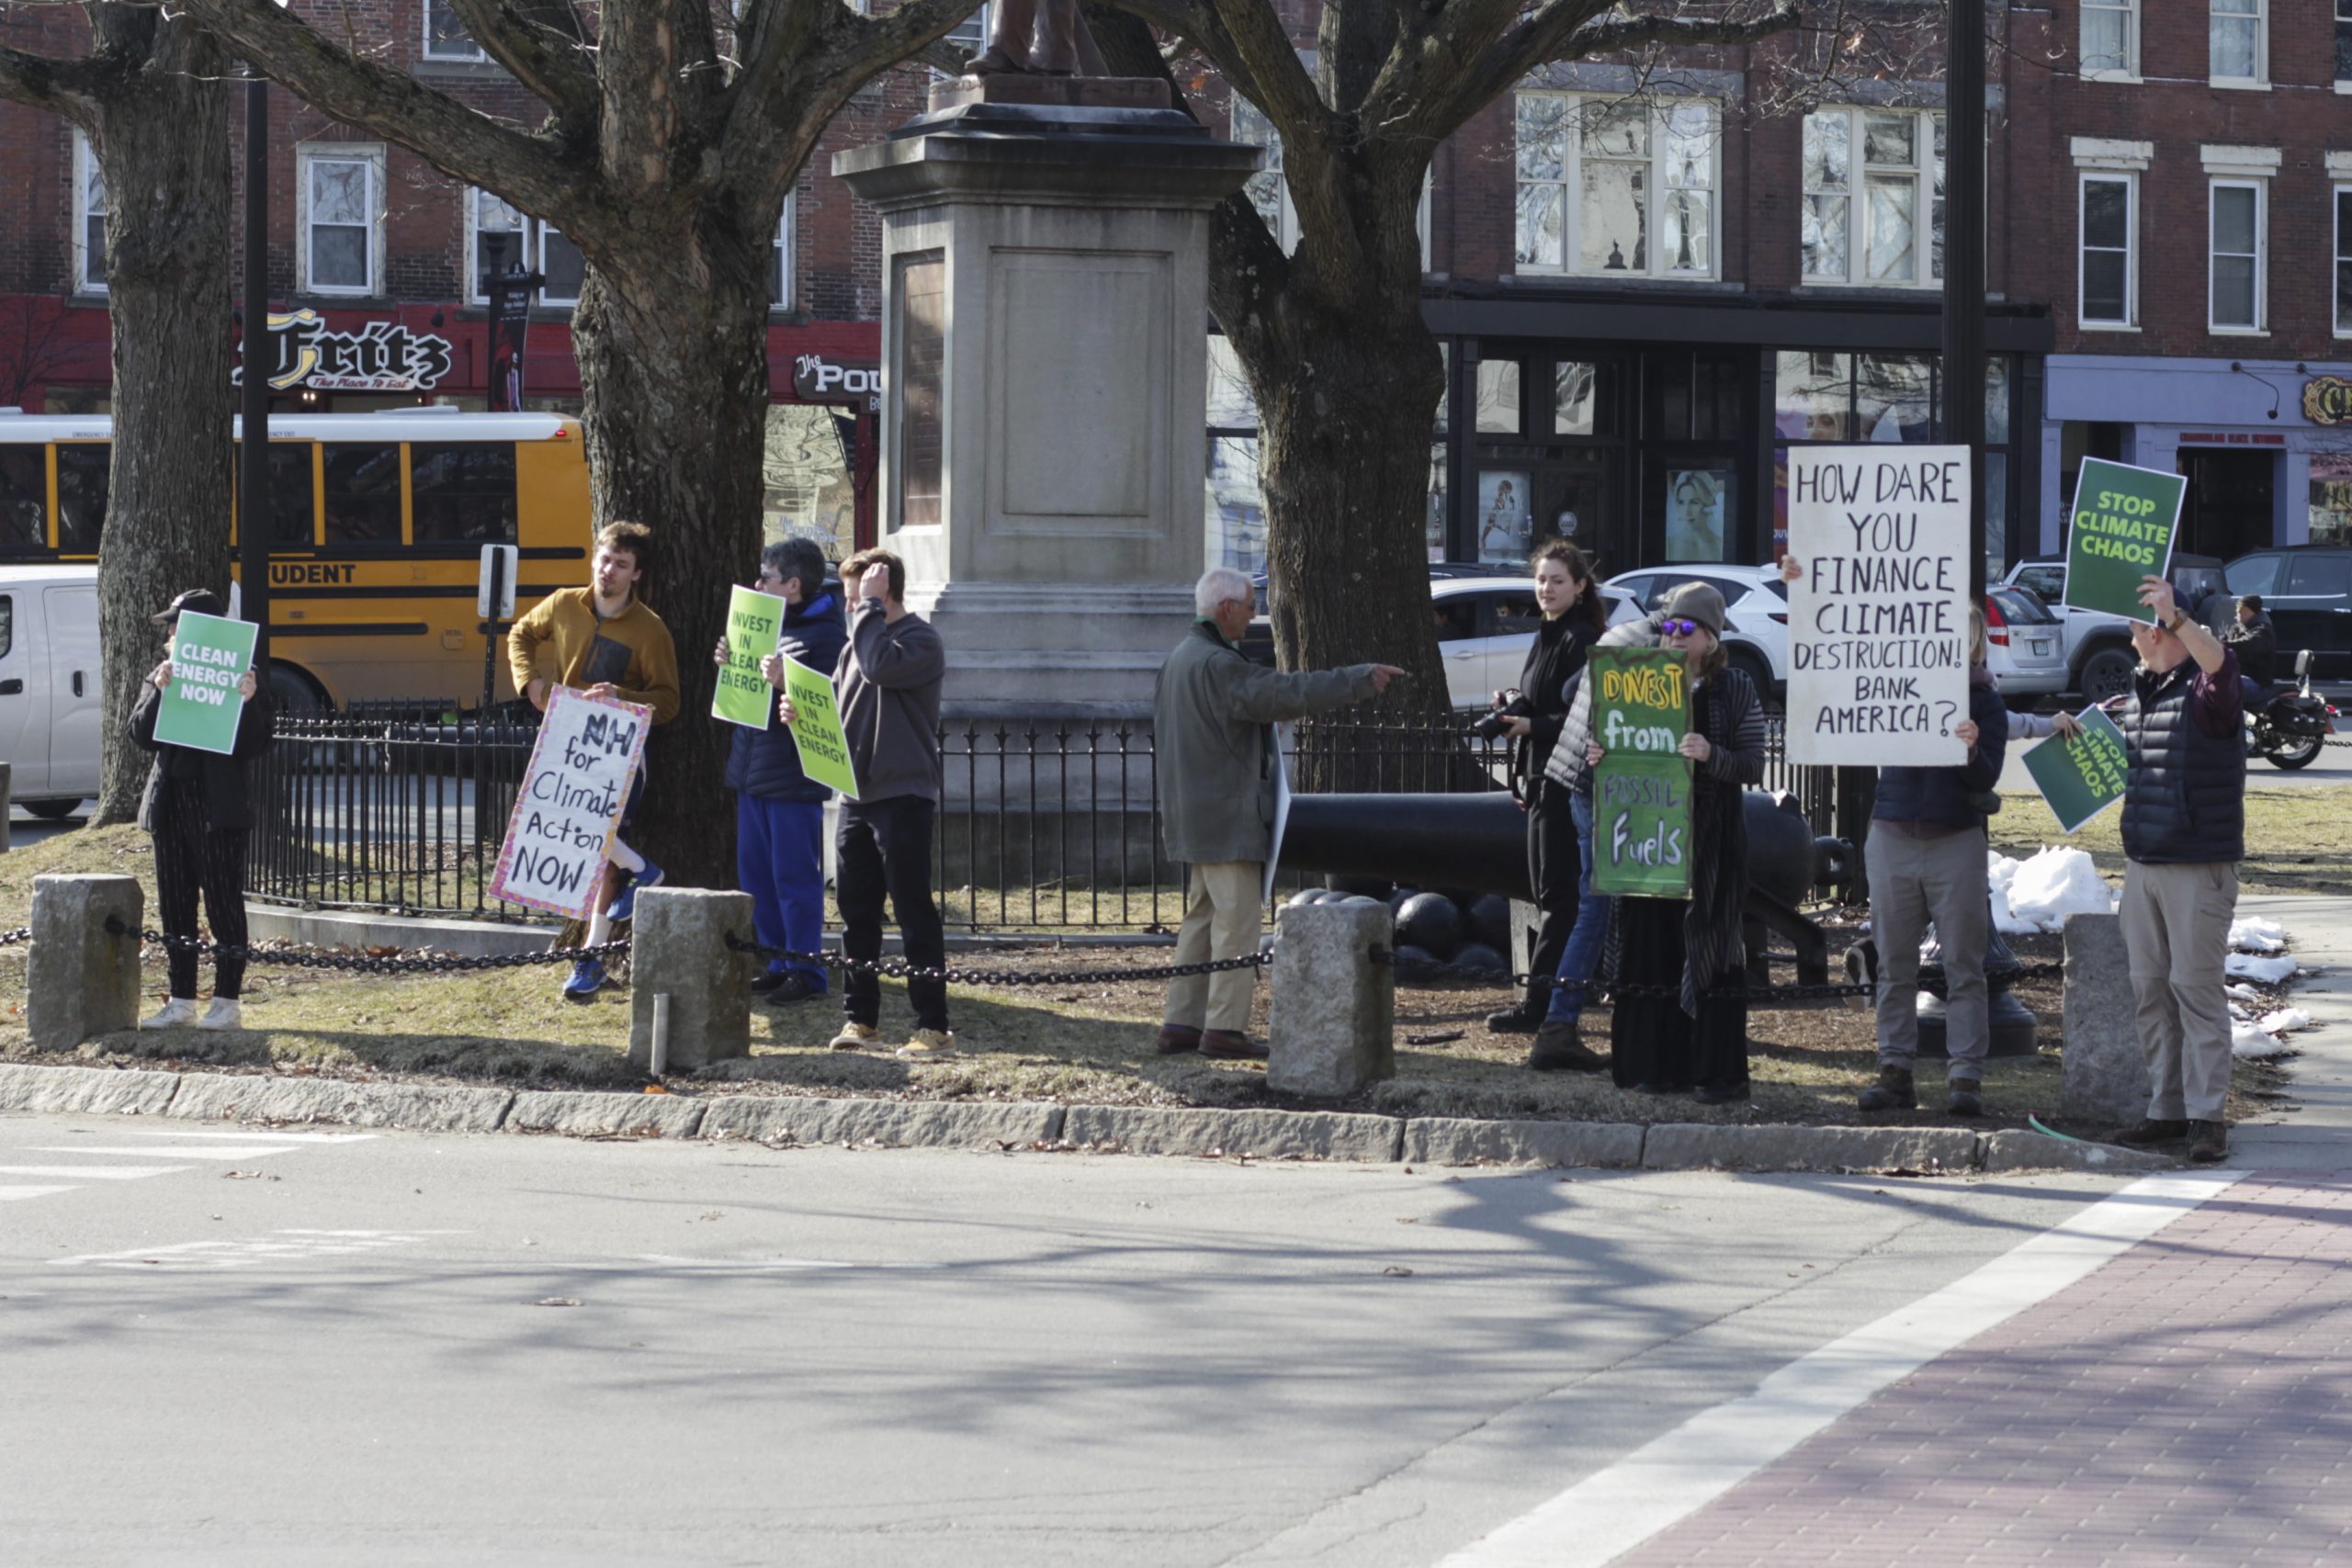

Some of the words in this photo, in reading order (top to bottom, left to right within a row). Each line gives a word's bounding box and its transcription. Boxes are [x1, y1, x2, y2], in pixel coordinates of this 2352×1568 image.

[232, 310, 452, 389] Fritz
[796, 354, 821, 378] The
[313, 378, 334, 387] The
[336, 378, 368, 387] Place
[372, 378, 383, 388] To
[386, 378, 410, 388] Eat
[1796, 464, 1862, 504] HOW
[1875, 463, 1961, 503] DARE
[2098, 491, 2155, 516] STOP
[1847, 513, 1917, 552] YOU
[2076, 510, 2169, 545] CLIMATE
[2081, 535, 2155, 565] CHAOS
[268, 564, 356, 583] UDENT
[1812, 557, 1955, 594] FINANCE
[732, 611, 773, 634] INVEST
[1815, 600, 1953, 636] CLIMATE
[180, 643, 238, 667] CLEAN
[739, 633, 752, 650] IN
[1794, 638, 1962, 670] DESTRUCTION!
[172, 661, 242, 689] ENERGY
[721, 669, 768, 694] ENERGY
[1603, 663, 1683, 709] DIVEST
[1855, 676, 1920, 701] BANK
[180, 682, 227, 706] NOW
[789, 680, 830, 710] INVEST
[803, 705, 819, 722] IN
[1815, 700, 1958, 737] AMERICA?
[582, 713, 637, 757] NH
[797, 718, 838, 746] CLEAN
[1603, 709, 1677, 753] from
[564, 736, 602, 772] for
[797, 734, 845, 765] ENERGY
[2094, 727, 2129, 769] STOP
[533, 771, 617, 818] Climate
[1603, 774, 1682, 808] FOSSIL
[526, 811, 604, 852] Action
[1612, 809, 1682, 866] Fuels
[512, 845, 586, 893] NOW
